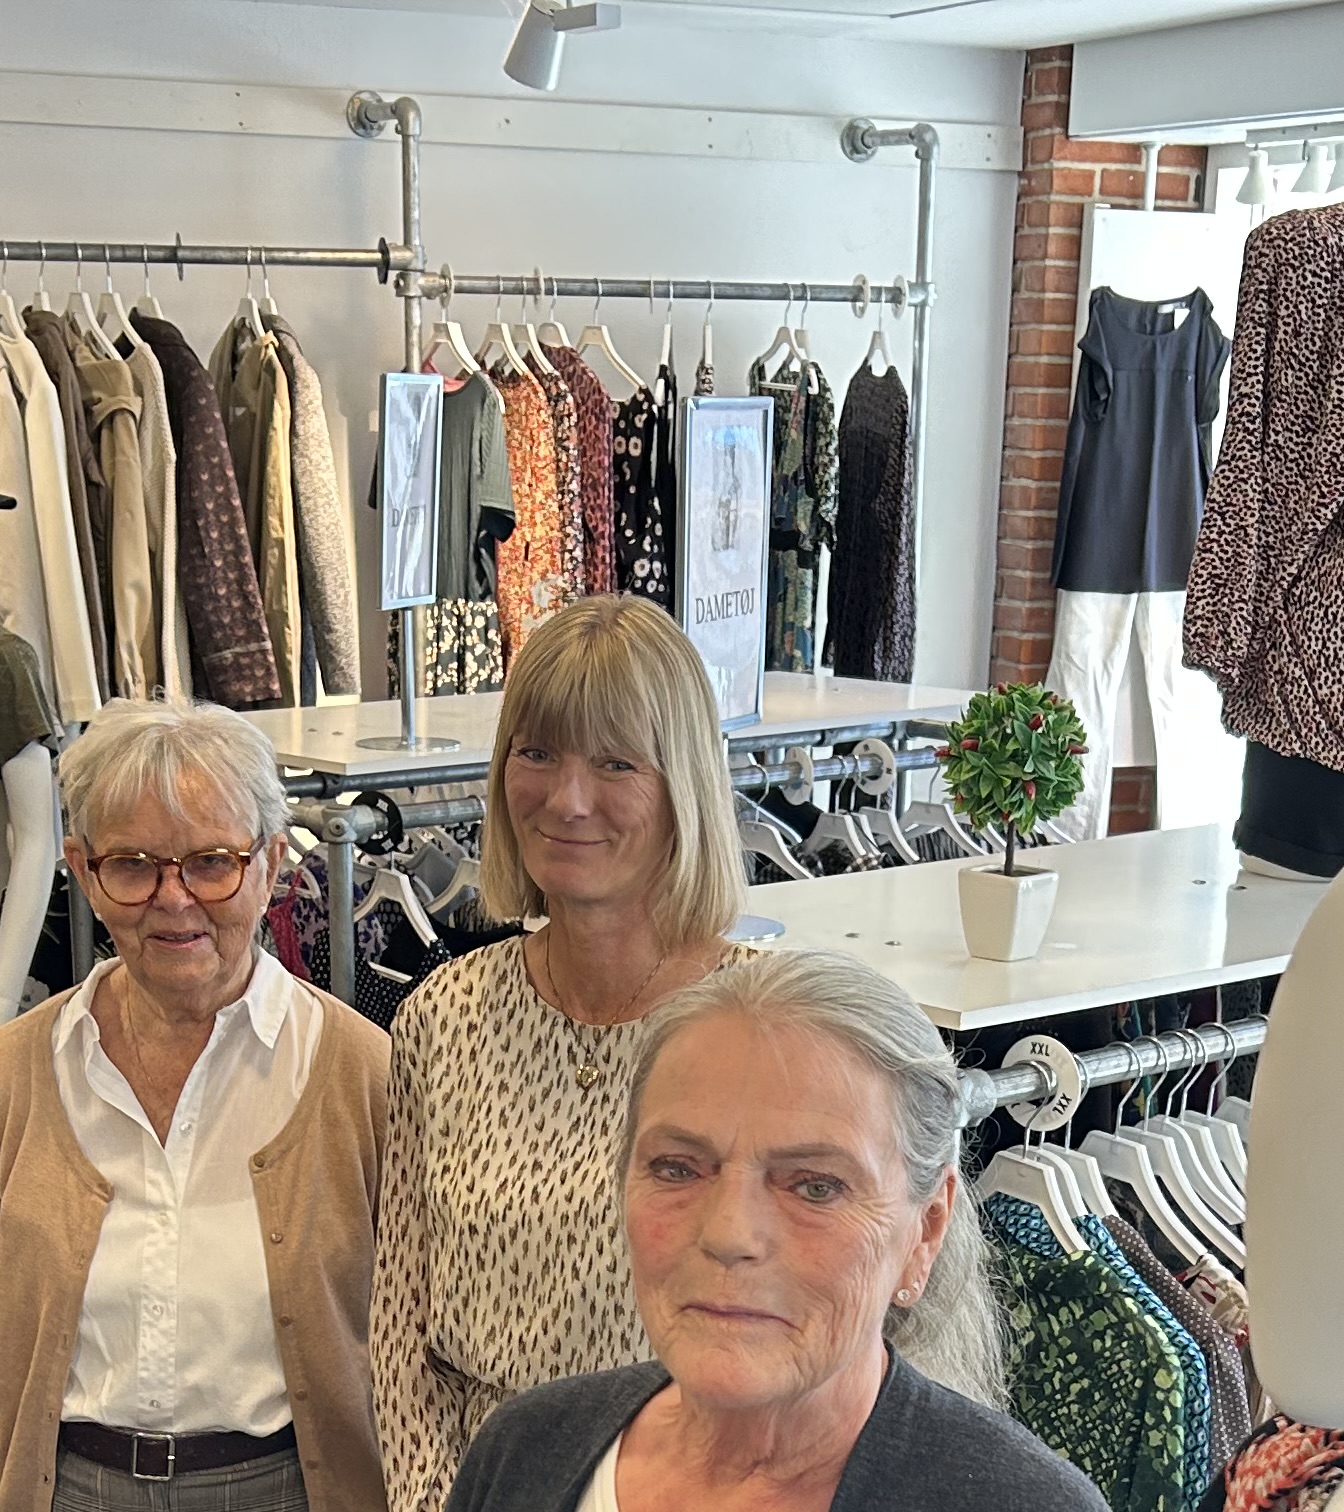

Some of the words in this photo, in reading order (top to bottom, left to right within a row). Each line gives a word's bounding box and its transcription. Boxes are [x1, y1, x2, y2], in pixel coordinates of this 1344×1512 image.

[695, 588, 755, 625] DAMETØJ
[1030, 1041, 1051, 1057] XXL
[1052, 1093, 1073, 1116] XXL
